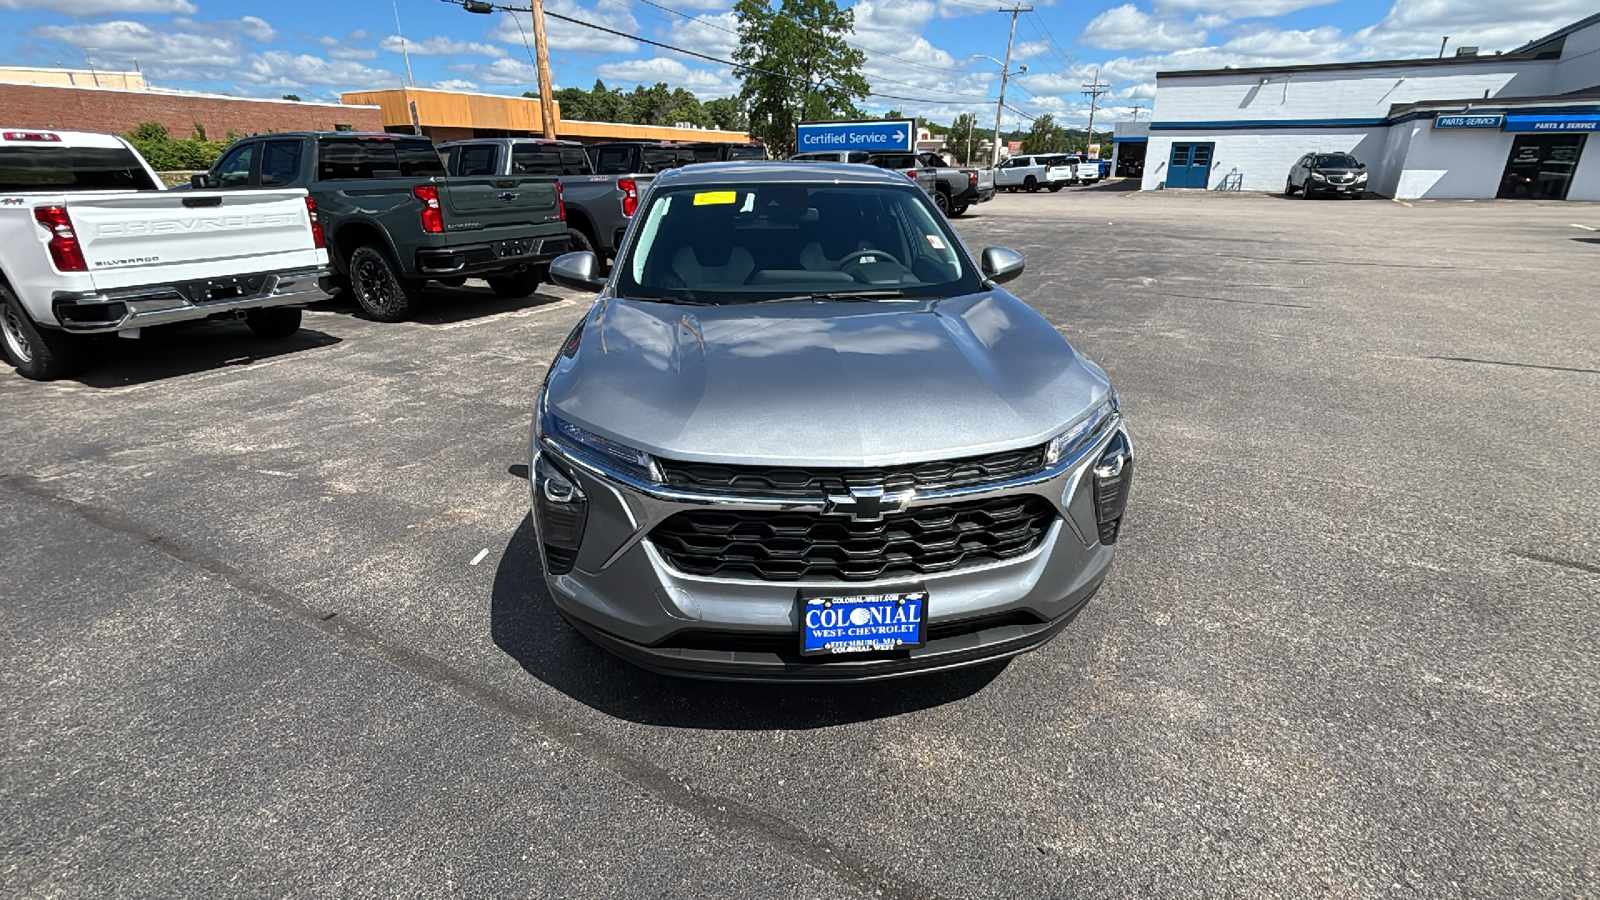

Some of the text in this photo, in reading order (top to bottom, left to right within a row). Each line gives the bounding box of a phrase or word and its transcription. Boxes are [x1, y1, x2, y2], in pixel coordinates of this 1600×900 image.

[803, 132, 887, 144] Certified Service
[97, 213, 298, 236] CHEVROLET
[94, 256, 160, 266] SILVERADO
[805, 604, 921, 628] COLONIAL
[847, 624, 916, 636] CHEVROLET
[873, 642, 895, 652] WEST
